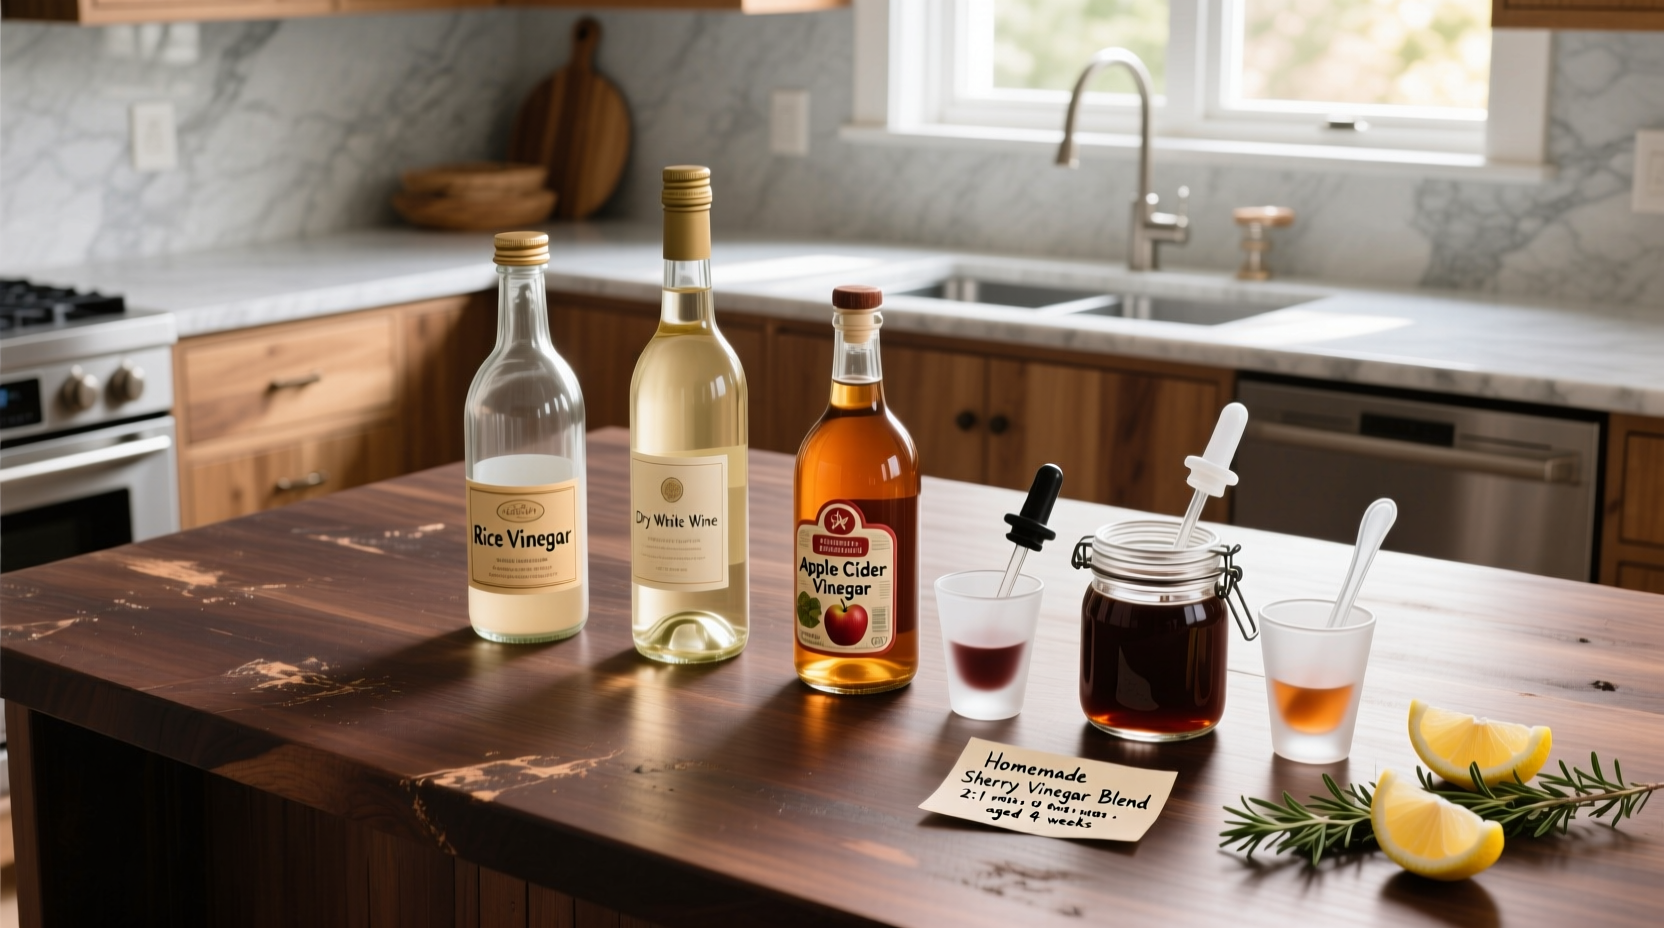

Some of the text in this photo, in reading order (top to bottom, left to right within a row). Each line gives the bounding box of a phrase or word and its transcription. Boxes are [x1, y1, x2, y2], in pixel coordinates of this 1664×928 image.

[636, 510, 718, 530] Dry White Wine
[474, 524, 572, 552] Rice Vinegar
[799, 556, 887, 579] Apple Cider
[813, 578, 872, 601] Vinegar
[984, 751, 1088, 784] Homemade
[960, 788, 986, 802] 2:1
[961, 770, 1020, 795] Sherry
[1028, 781, 1092, 805] Vinegar
[1097, 788, 1152, 810] Blend
[985, 806, 1024, 821] aged
[1029, 811, 1041, 823] 4
[1047, 816, 1093, 829] weeks
